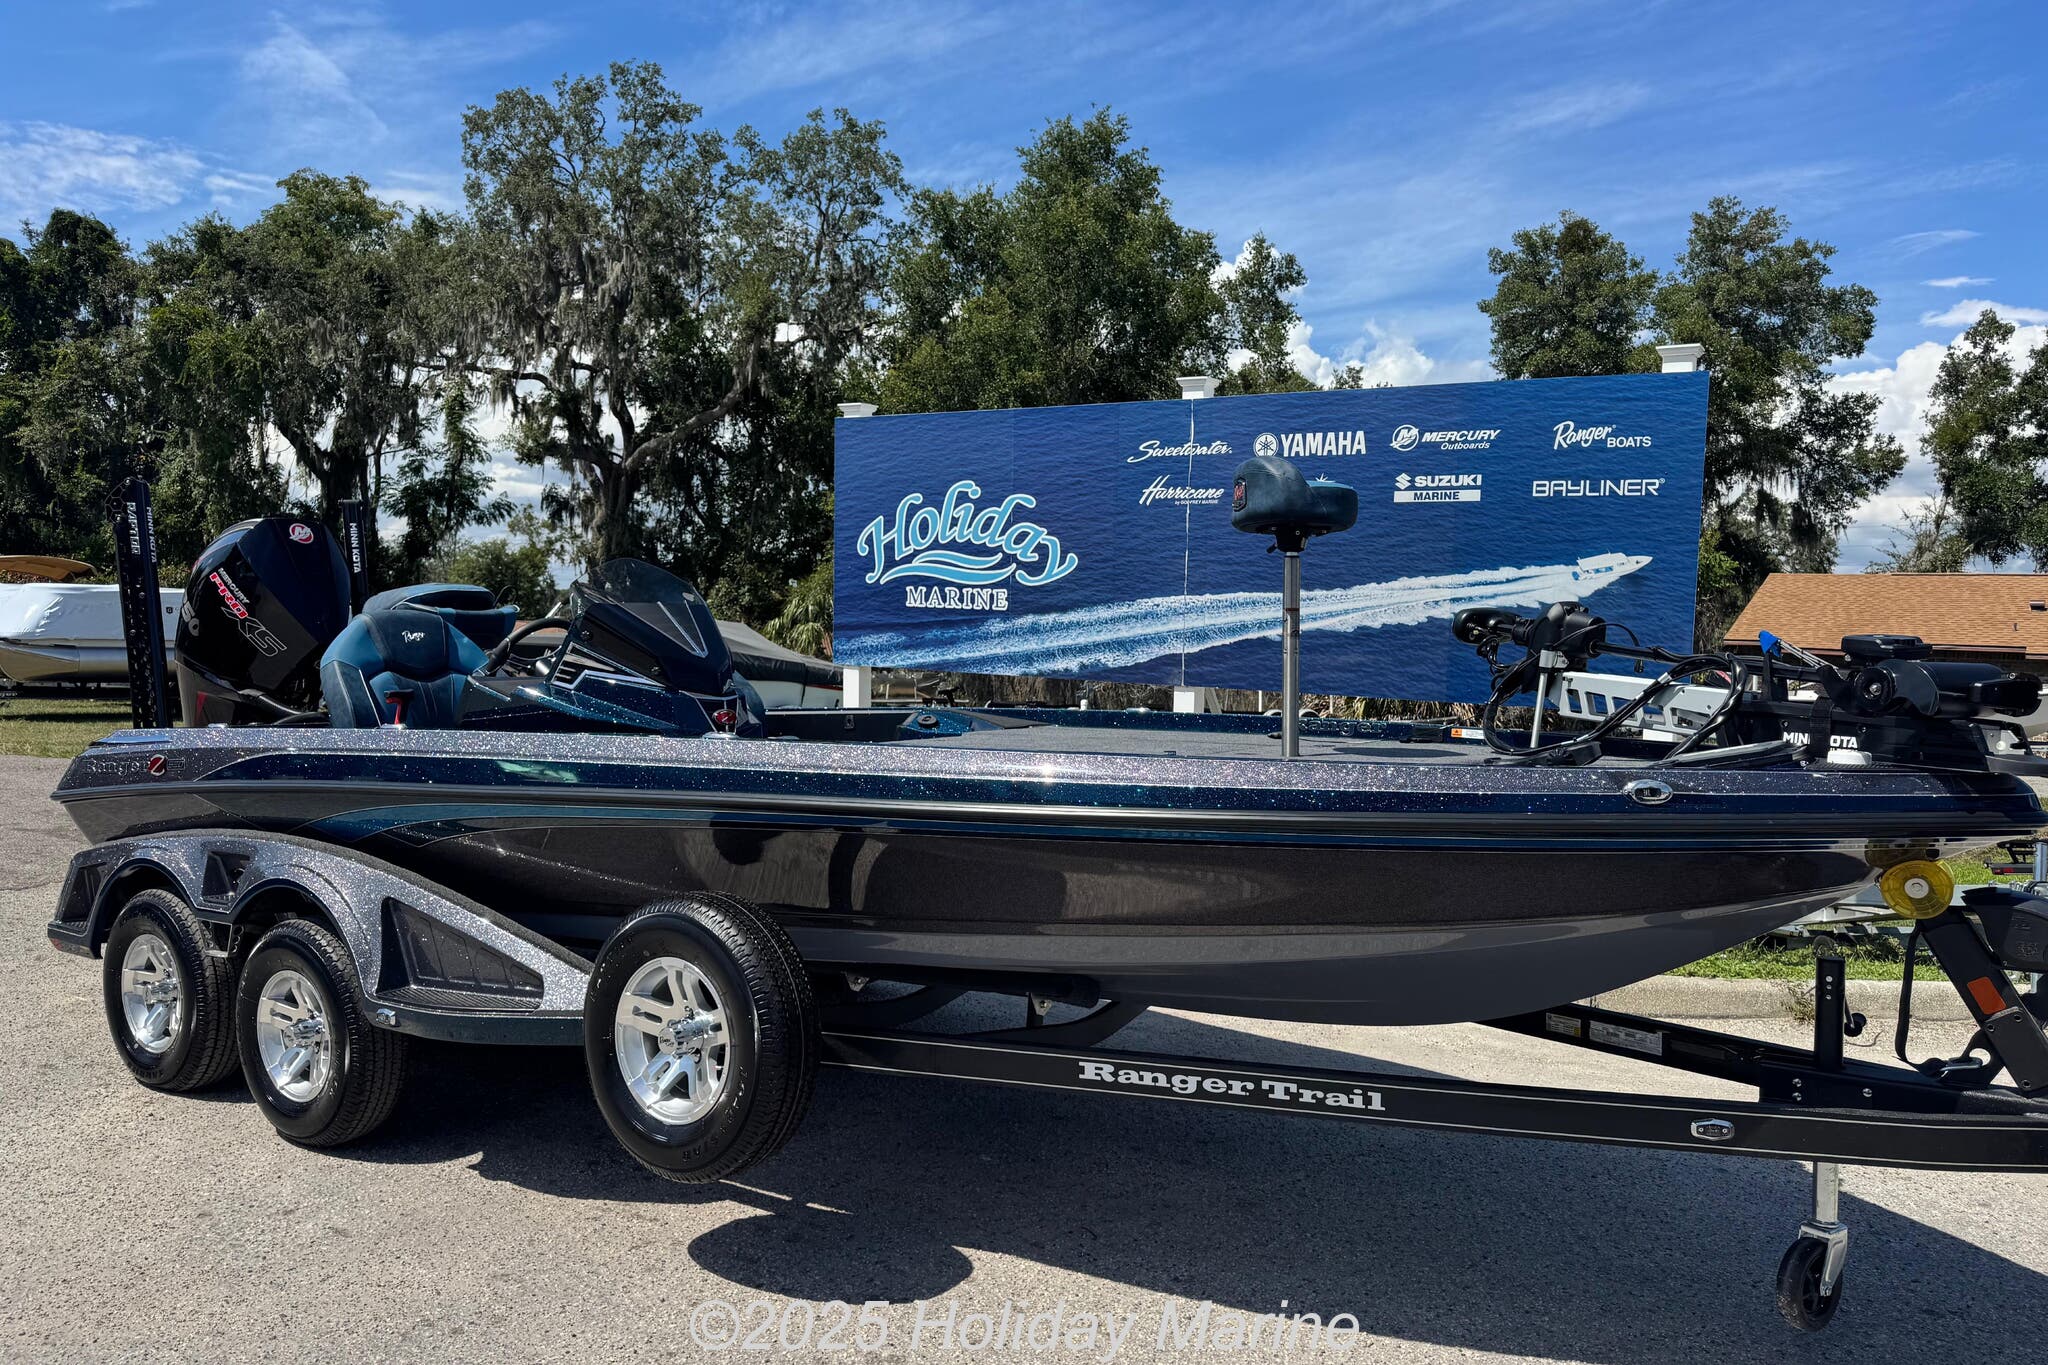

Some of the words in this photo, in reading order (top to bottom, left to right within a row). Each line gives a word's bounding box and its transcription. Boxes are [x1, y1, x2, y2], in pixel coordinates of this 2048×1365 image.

[1280, 430, 1367, 457] YAMAHA
[1421, 429, 1501, 442] MERCURY
[1440, 441, 1491, 450] Outboards
[1606, 436, 1652, 448] BOATS
[1138, 474, 1225, 506] Hurricane
[1414, 474, 1482, 487] SUZUKI
[1413, 491, 1460, 501] MARINE
[146, 506, 155, 534] MINN
[349, 522, 359, 547] MINN
[856, 480, 1078, 586] Holiday
[149, 535, 157, 563] KOTA
[352, 549, 361, 573] KOTA
[218, 567, 250, 604] MERCURY
[905, 585, 1009, 611] MARINE
[1782, 731, 1811, 745] MIN
[1829, 735, 1858, 749] OTA
[1078, 1061, 1255, 1095] Ranger
[1261, 1079, 1386, 1111] Trail
